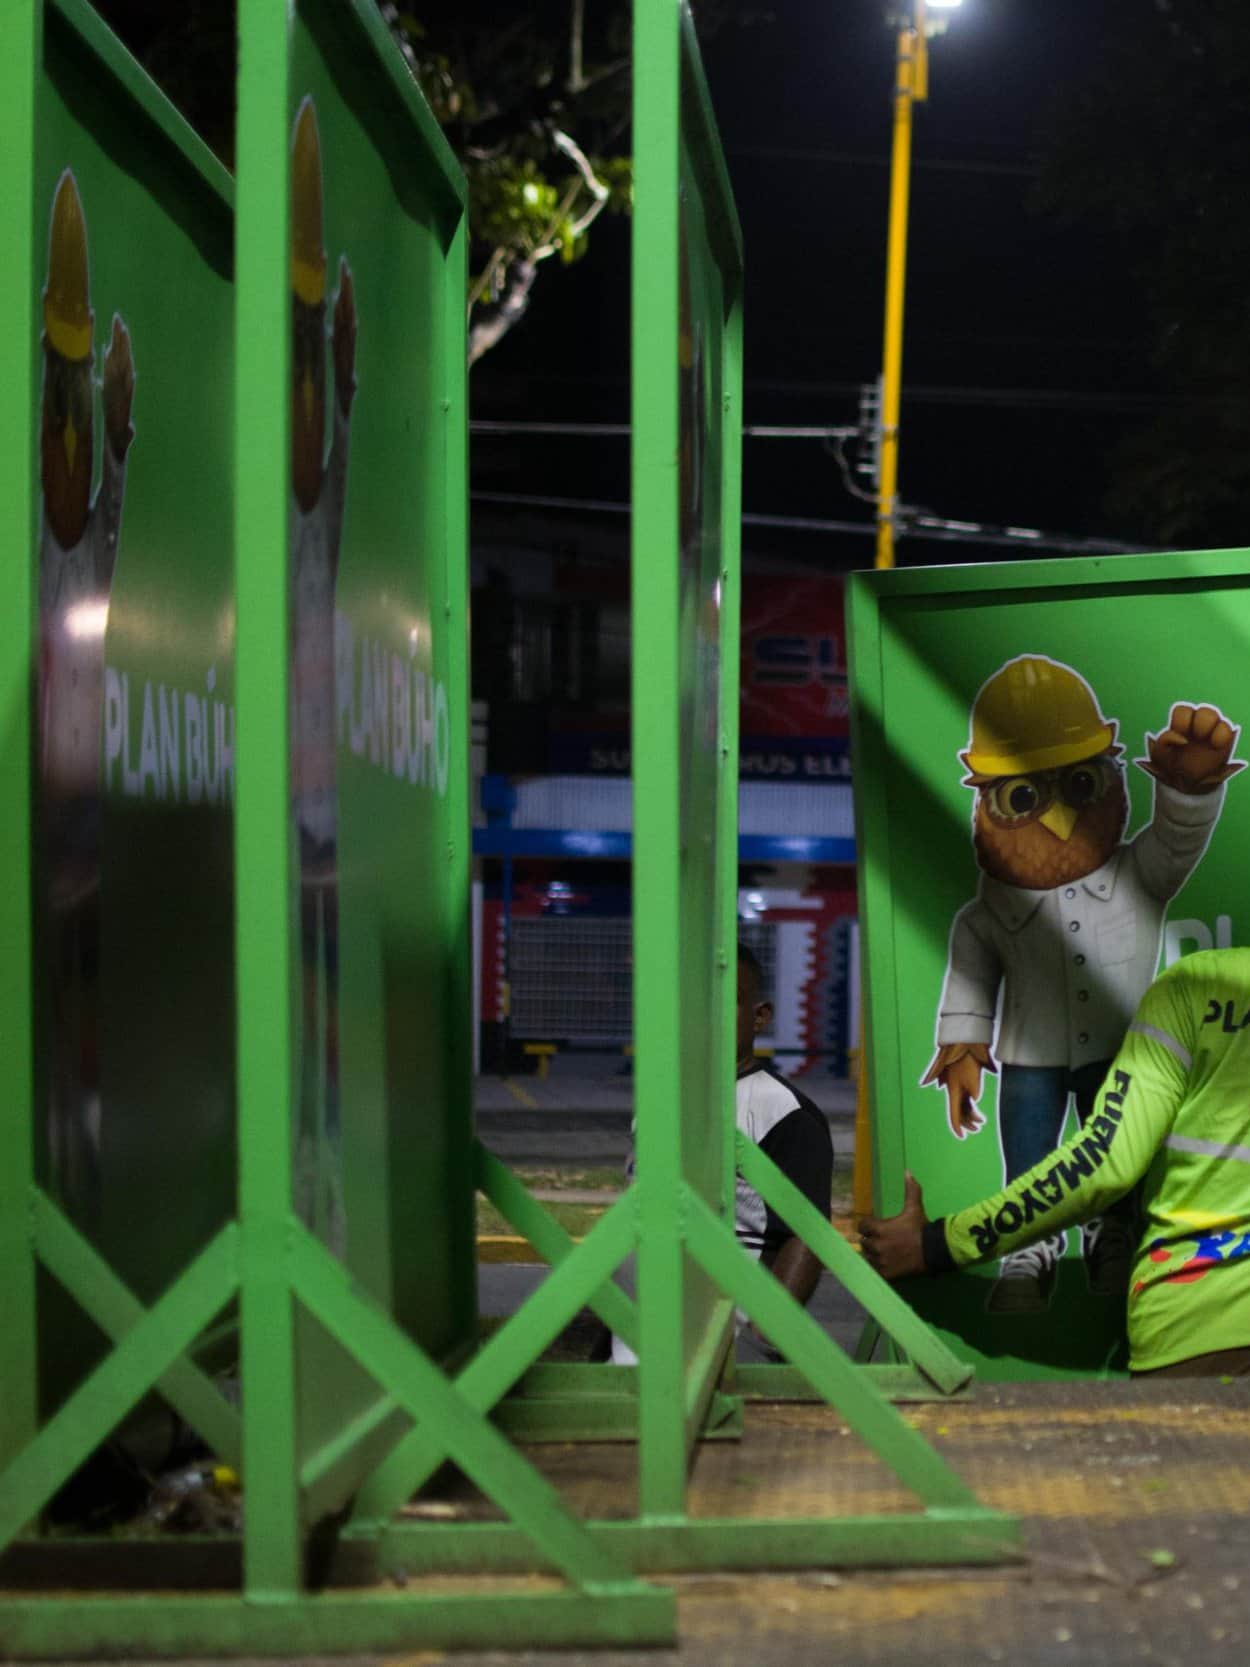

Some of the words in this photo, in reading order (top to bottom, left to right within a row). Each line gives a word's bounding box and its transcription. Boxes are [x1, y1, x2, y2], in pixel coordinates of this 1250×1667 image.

[104, 666, 179, 799] PLAN
[184, 665, 235, 802] BÚH
[391, 631, 447, 795] BÚHO
[968, 1069, 1132, 1255] FUENMAYOR
